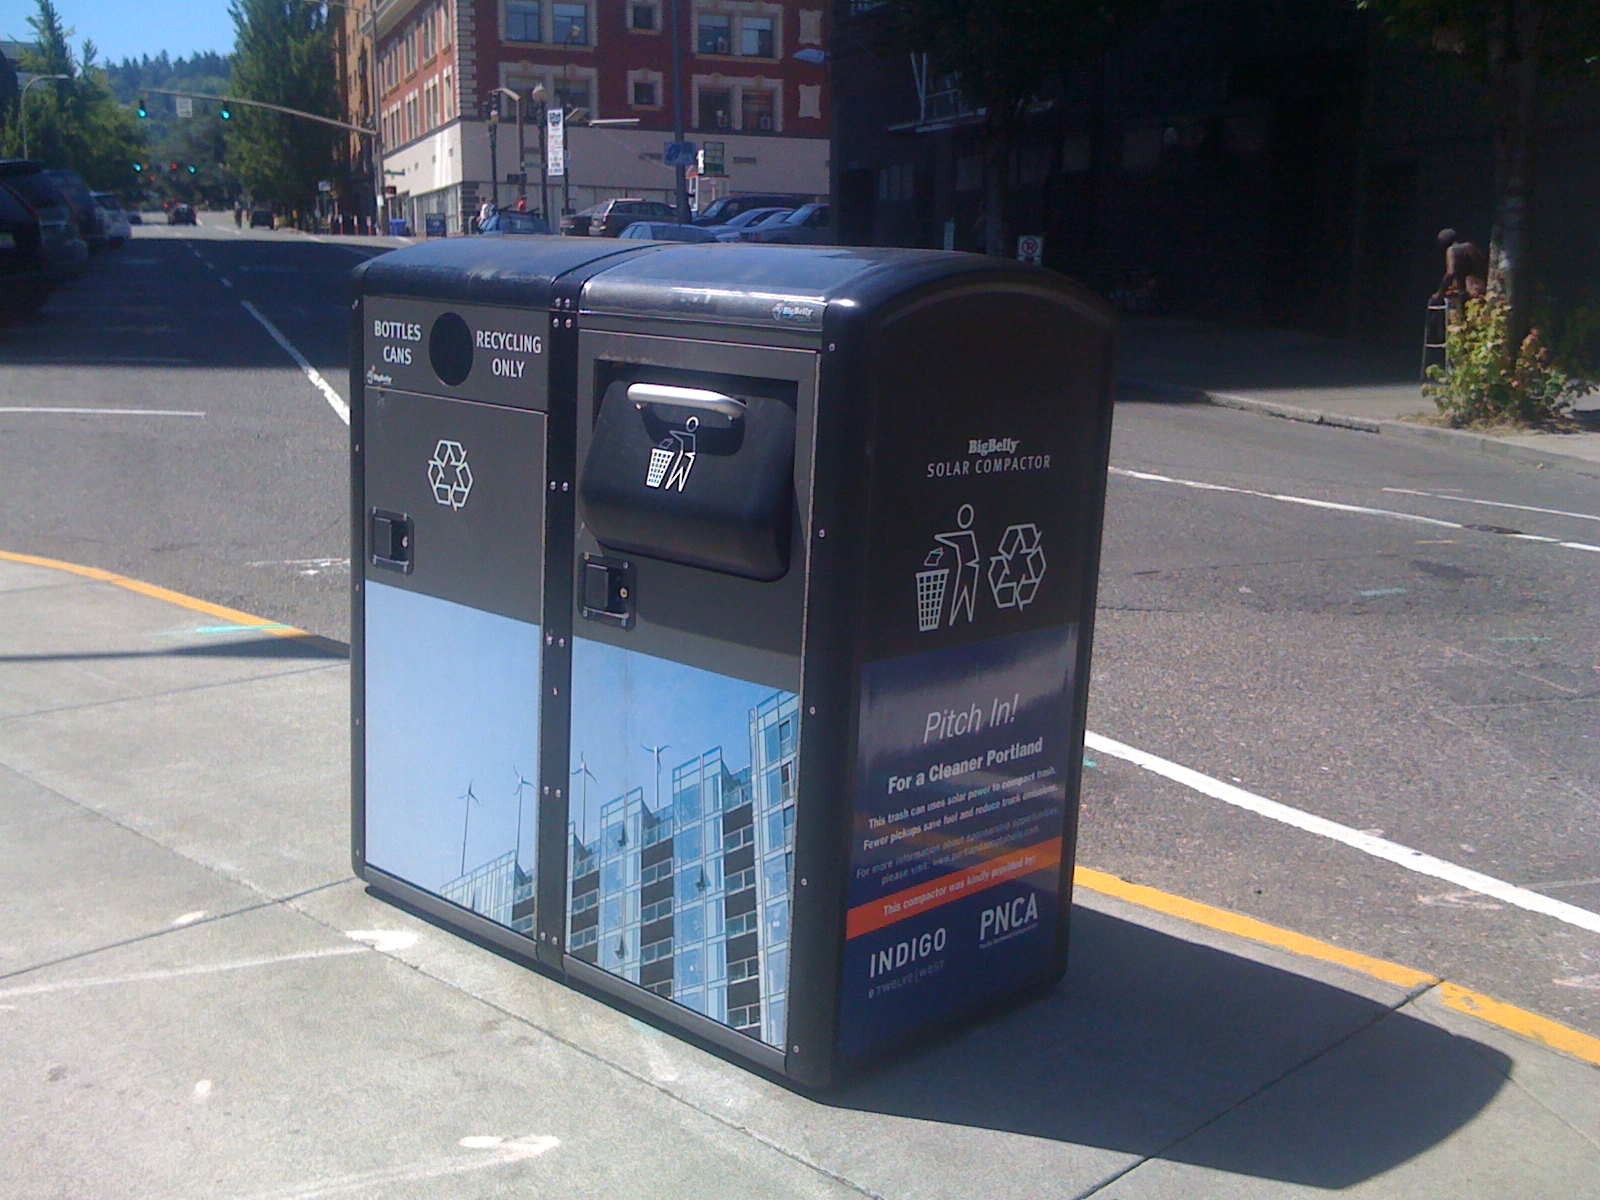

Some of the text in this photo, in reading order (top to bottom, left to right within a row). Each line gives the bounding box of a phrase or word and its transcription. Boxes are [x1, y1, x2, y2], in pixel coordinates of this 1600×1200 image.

[374, 320, 421, 341] BOTTLES
[476, 330, 541, 354] RECYCLING
[383, 346, 412, 365] CANS
[492, 358, 525, 378] ONLY
[968, 438, 1019, 456] BigBelly
[927, 455, 1051, 478] SOLAR COMPACTOR
[923, 693, 1019, 744] Pitch In!
[888, 736, 1043, 794] For a Cleaner Portland
[868, 816, 886, 829] This
[888, 808, 909, 823] trash
[911, 805, 926, 817] can
[927, 799, 946, 811] uses
[947, 792, 967, 806] solar
[967, 786, 991, 801] power
[992, 782, 1001, 792] to
[1002, 772, 1035, 789] compact
[863, 835, 888, 851] Fewer
[890, 825, 922, 844] pickups
[923, 819, 942, 832] save
[943, 812, 958, 825] fuel
[960, 807, 974, 820] and
[975, 801, 1001, 815] reduce
[1002, 793, 1021, 807] truck
[856, 868, 870, 879] For
[872, 860, 893, 874] more
[895, 845, 941, 866] information
[881, 869, 909, 886] please
[884, 904, 900, 916] This
[903, 887, 947, 909] compactor
[948, 880, 965, 893] was
[967, 869, 990, 886] kindly
[991, 860, 1024, 878] provided
[979, 893, 1038, 941] PNCA
[870, 928, 947, 978] INDIGO
